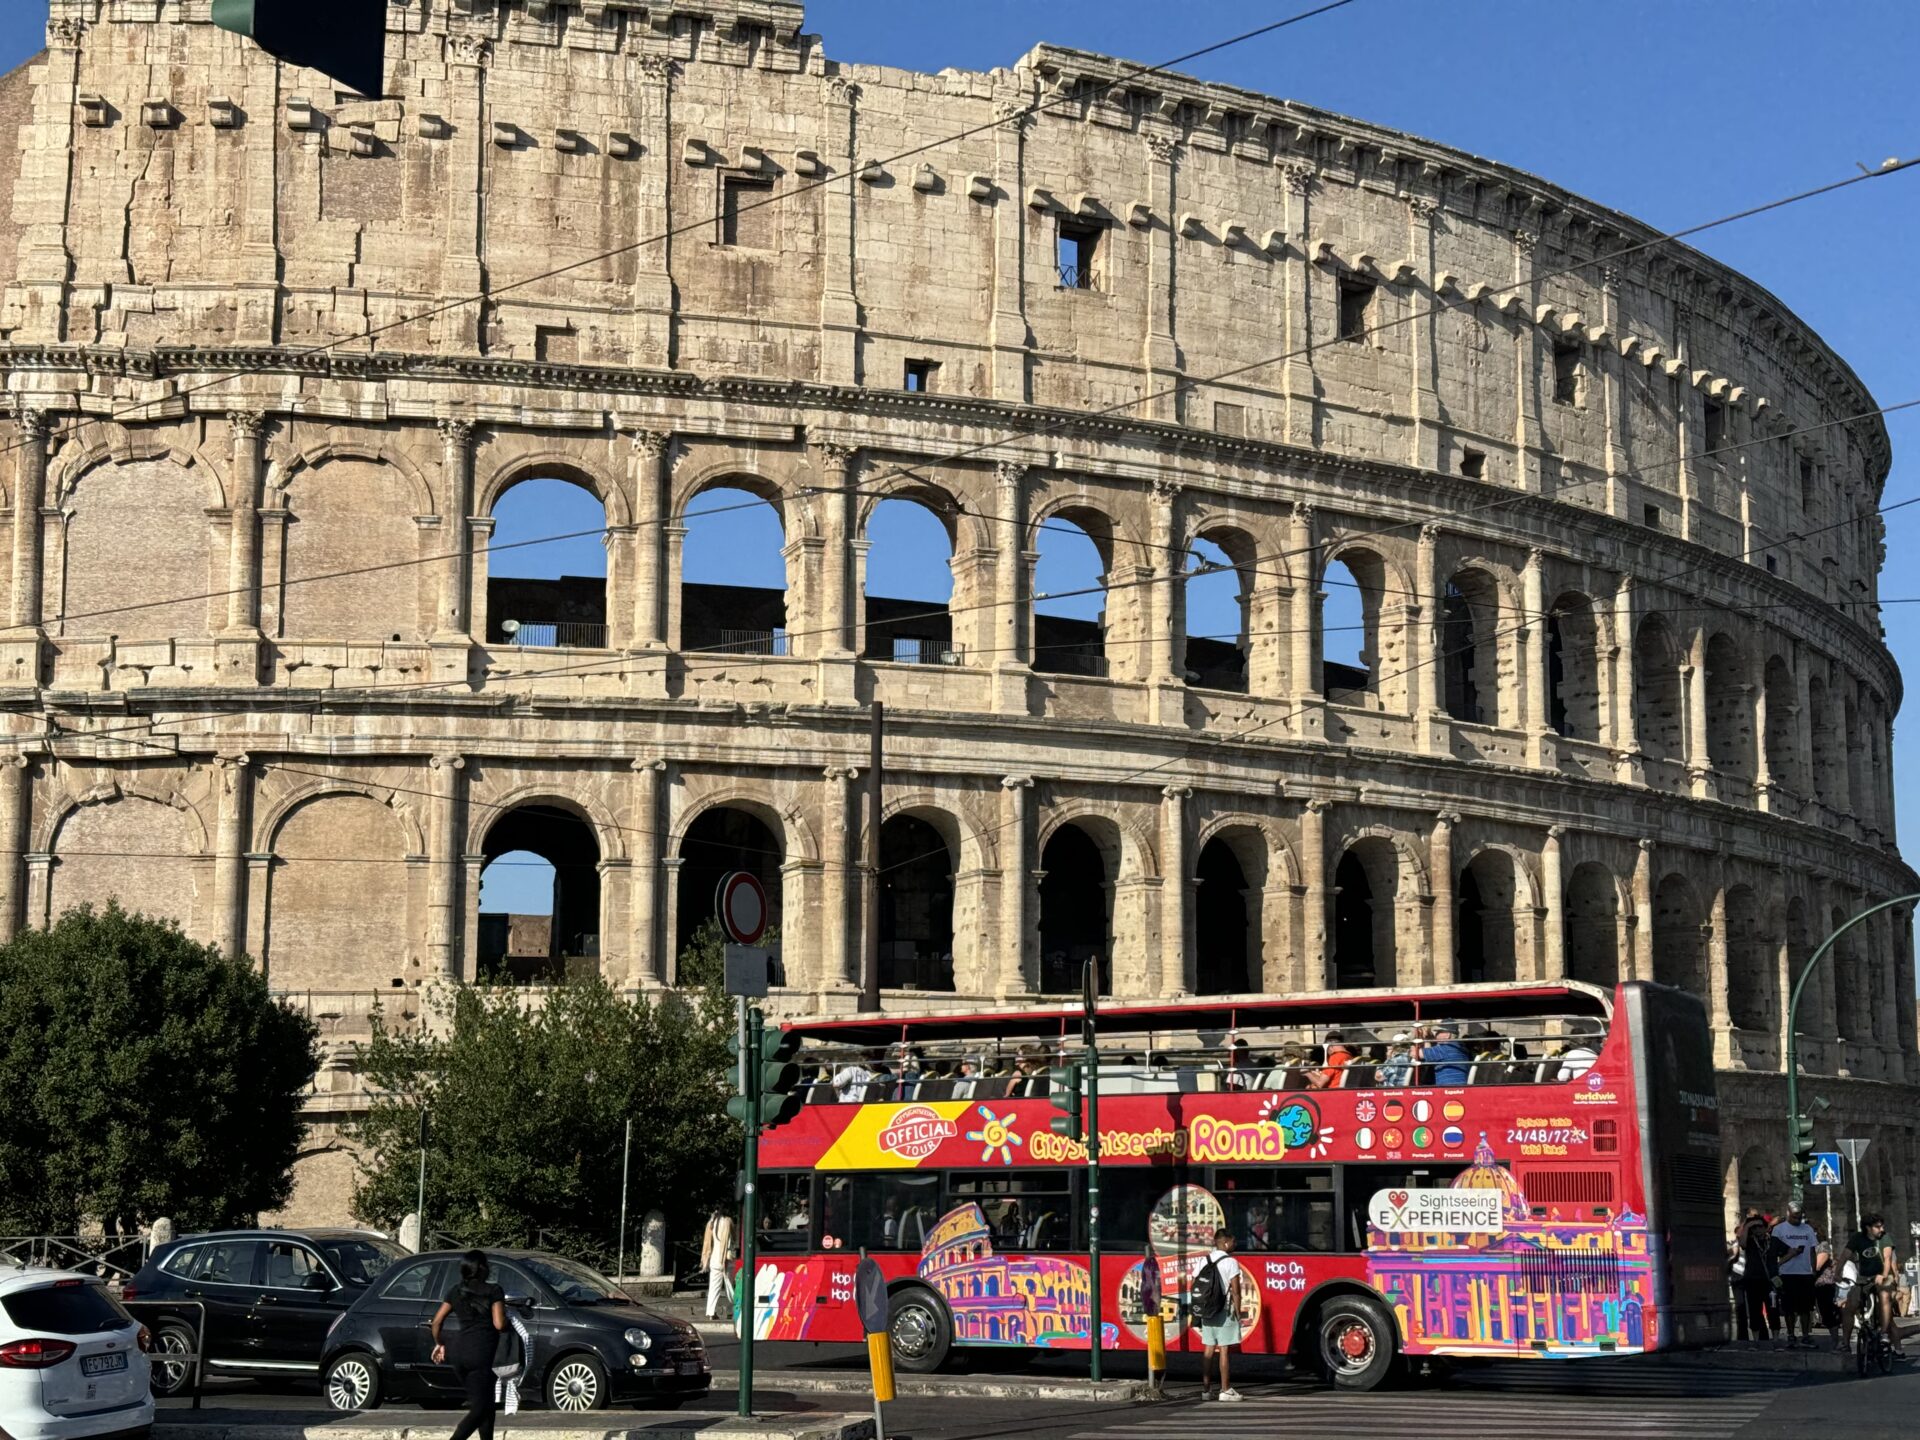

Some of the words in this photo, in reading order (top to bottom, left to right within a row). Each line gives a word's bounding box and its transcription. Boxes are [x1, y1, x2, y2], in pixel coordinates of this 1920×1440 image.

[886, 1121, 953, 1147] OFFICIAL
[1030, 1128, 1188, 1162] Citysihtseeing
[1191, 1114, 1285, 1162] Roma
[1507, 1129, 1570, 1144] 24/48/72
[906, 1140, 936, 1156] TOUR
[1520, 1144, 1542, 1155] Valid
[1542, 1144, 1568, 1155] Ticket
[1420, 1194, 1498, 1210] Sightseeing
[1380, 1207, 1499, 1229] EXPERIENCE
[1266, 1261, 1287, 1275] Hop
[1289, 1261, 1304, 1274] On
[832, 1272, 851, 1286] Hop
[1266, 1277, 1287, 1291] Hop
[1290, 1277, 1306, 1290] Off
[831, 1288, 851, 1302] Hop
